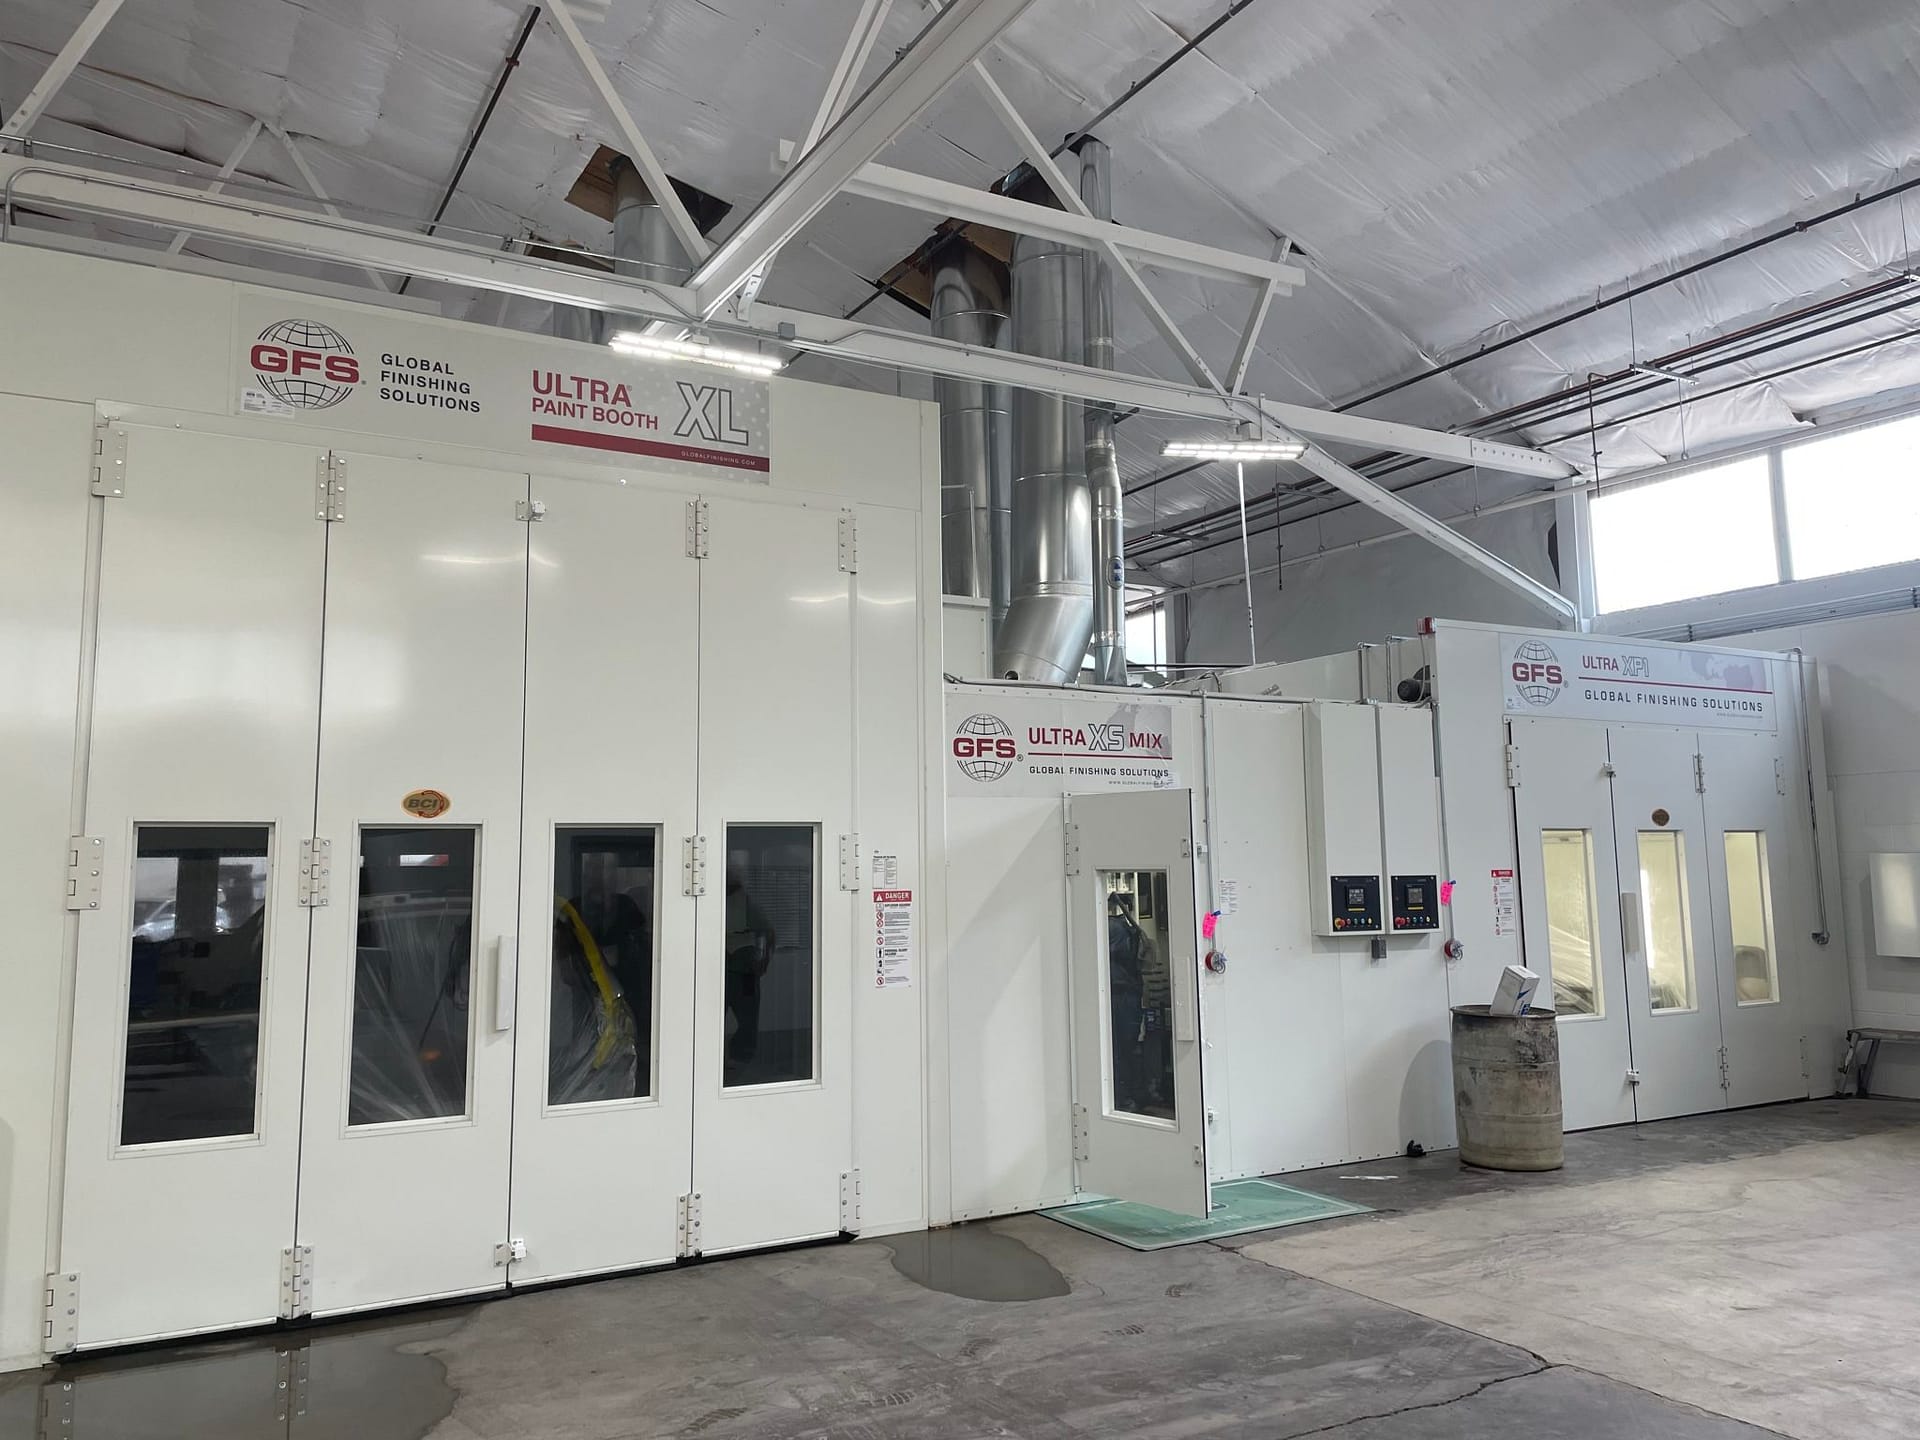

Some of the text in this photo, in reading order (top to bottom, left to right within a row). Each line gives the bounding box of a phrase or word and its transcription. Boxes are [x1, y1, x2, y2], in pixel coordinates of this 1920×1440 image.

[250, 344, 360, 384] GFS
[381, 353, 454, 376] GLOBAL
[381, 371, 471, 395] FINISHING
[532, 370, 632, 407] ULTRA
[380, 388, 481, 413] SOLUTIONS
[532, 397, 659, 430] PAINT BOOTH
[673, 381, 749, 446] XL
[1512, 662, 1563, 684] GFS
[1583, 655, 1619, 671] ULTRA
[1585, 689, 1763, 712] GLOBAL FINISHING SOLUTIONS
[953, 737, 1017, 758] GFS
[1129, 732, 1163, 749] MIX
[1029, 766, 1169, 777] GLOBAL FINISHING SOLUTIONS
[408, 799, 438, 808] BCI
